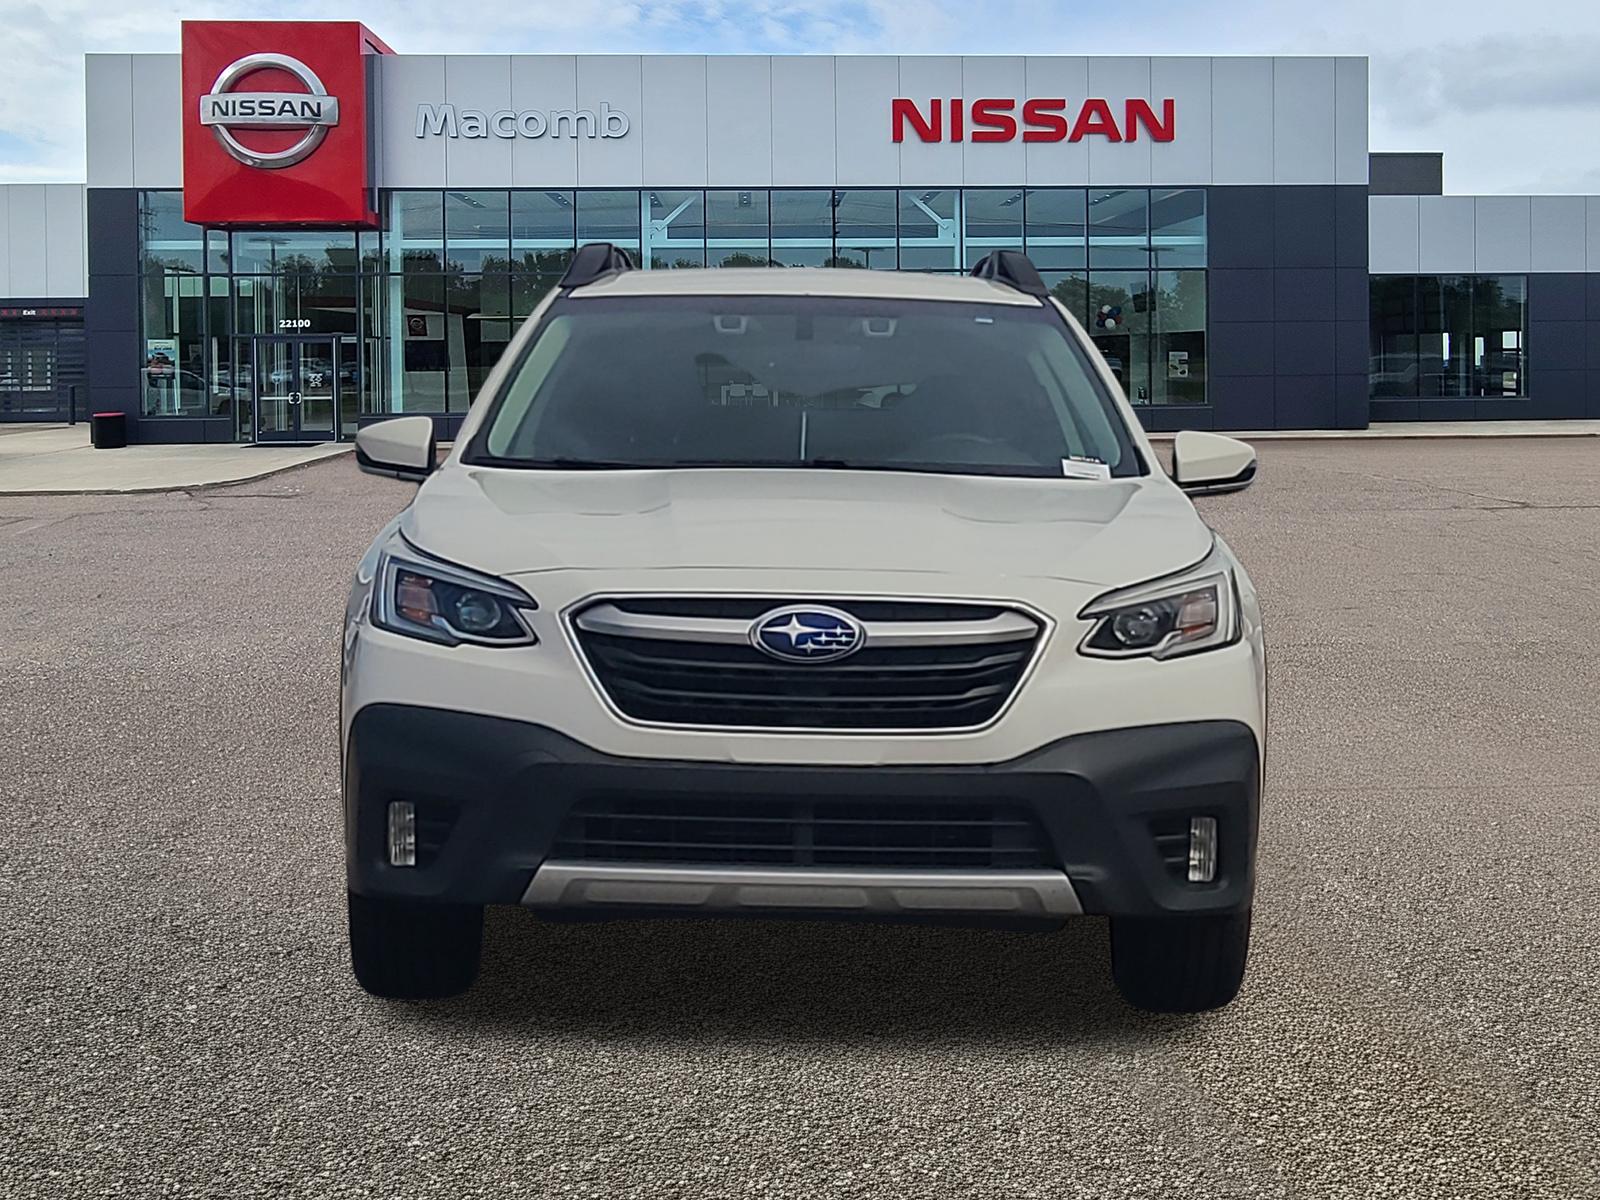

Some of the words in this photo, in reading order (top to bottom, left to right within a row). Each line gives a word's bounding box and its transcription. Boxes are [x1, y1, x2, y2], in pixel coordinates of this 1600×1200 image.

[212, 100, 321, 117] NISSAN
[415, 102, 629, 138] Macomb
[892, 98, 1175, 142] NISSAN
[279, 319, 311, 328] 22100
